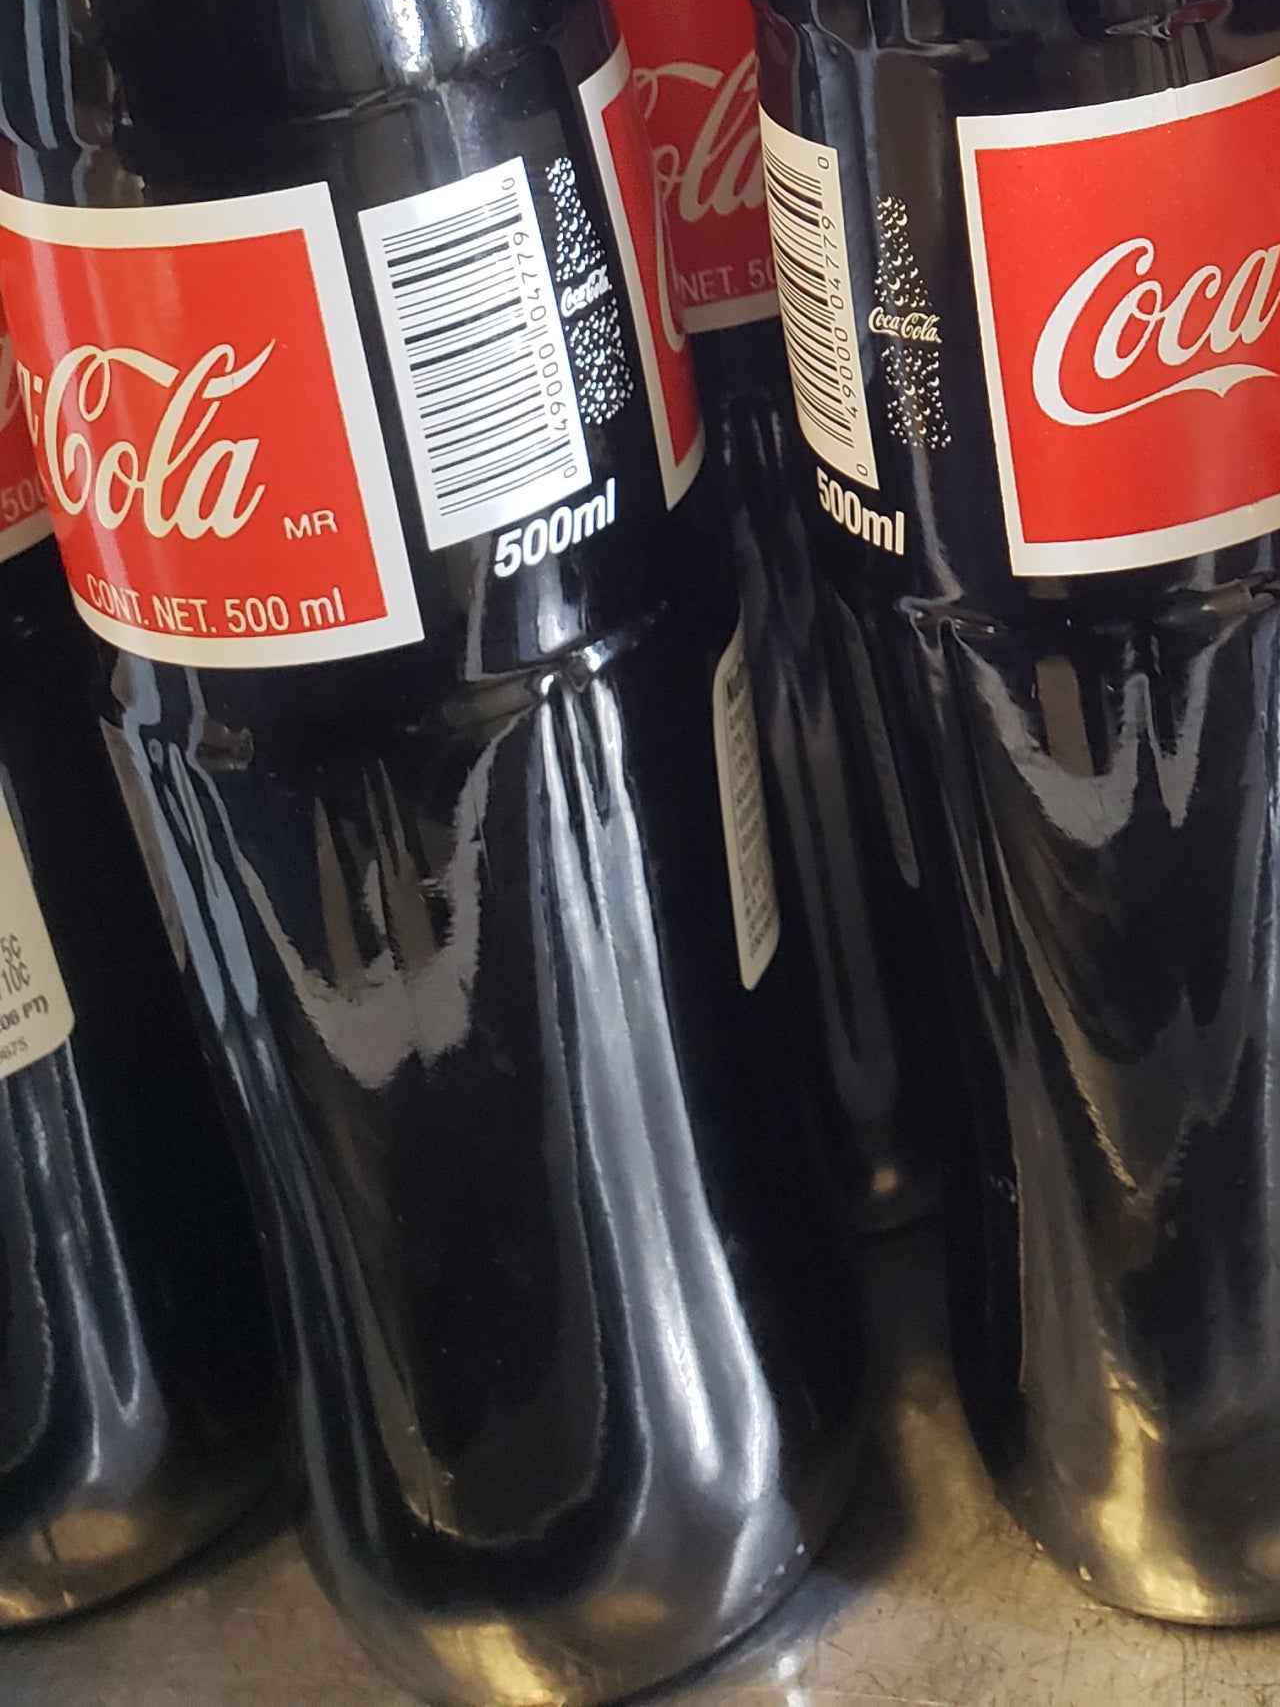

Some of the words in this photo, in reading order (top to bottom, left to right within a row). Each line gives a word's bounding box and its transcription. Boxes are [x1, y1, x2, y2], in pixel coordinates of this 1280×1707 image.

[501, 177, 515, 191] 0
[817, 156, 830, 170] 0
[512, 231, 548, 322] 04779
[821, 215, 846, 311] 04779
[868, 306, 941, 343] Coca-Cola
[538, 342, 569, 432] 49000
[835, 328, 860, 419] 49000
[564, 465, 577, 478] 0
[856, 462, 869, 476] 0
[283, 509, 338, 541] MR
[493, 477, 616, 578] 500ml
[816, 465, 905, 556] 500ml
[86, 573, 149, 626] CONT.
[152, 595, 217, 633] NET.
[225, 595, 290, 634] 500
[299, 586, 346, 629] ml
